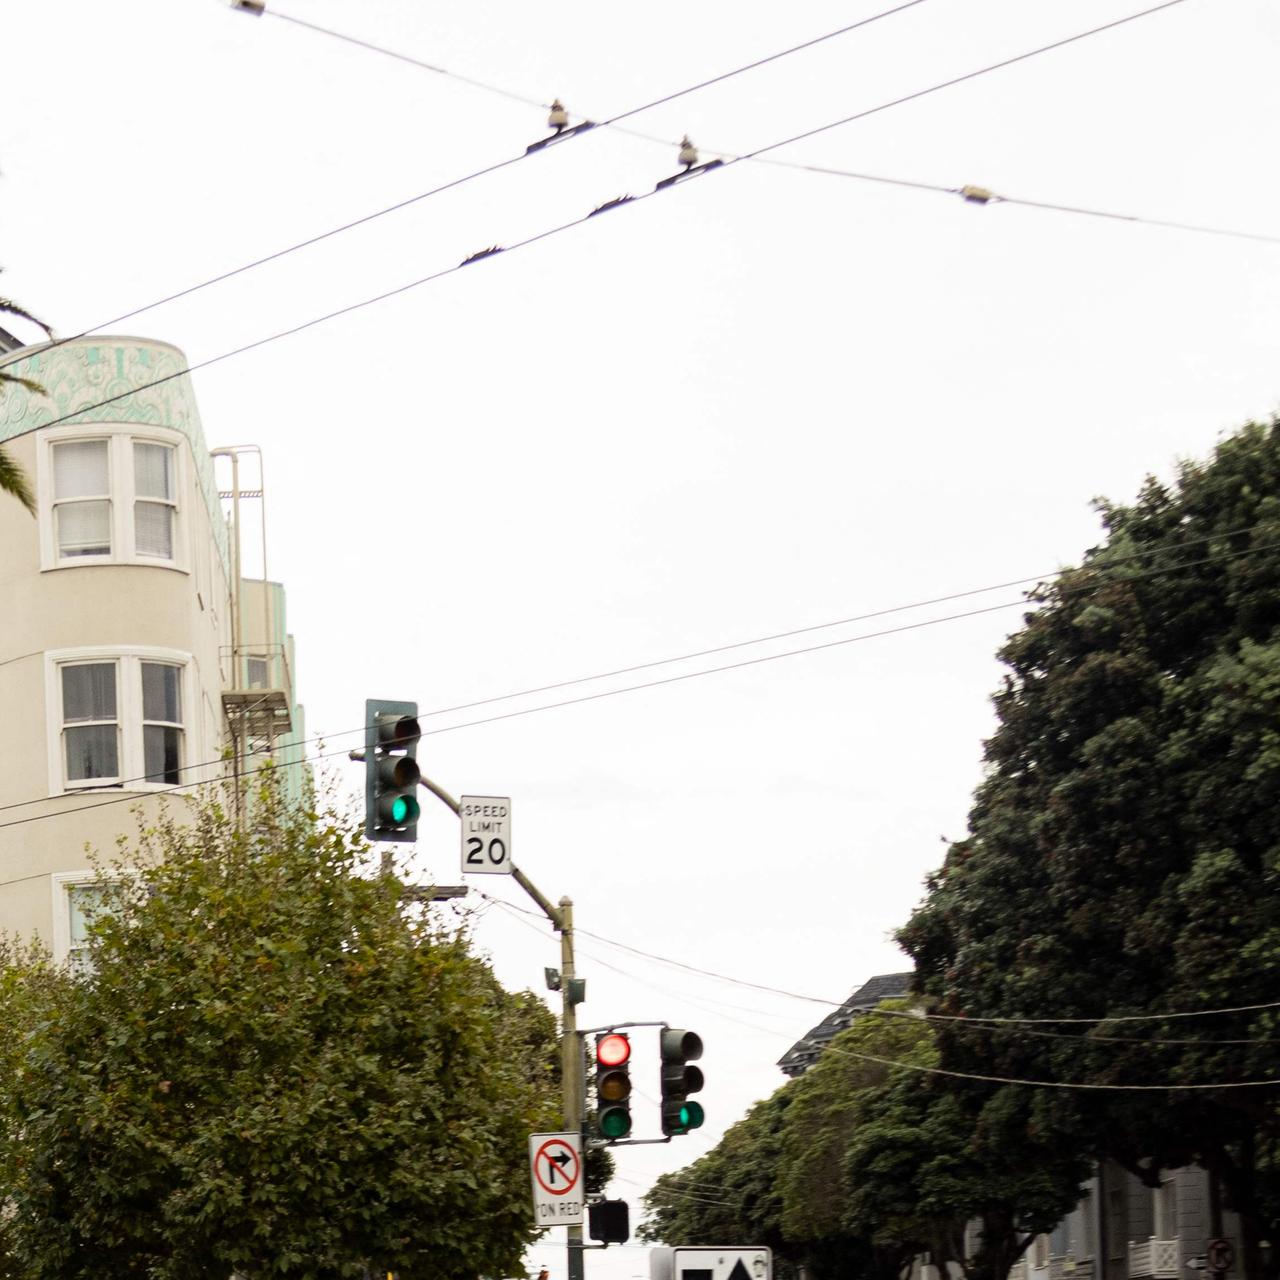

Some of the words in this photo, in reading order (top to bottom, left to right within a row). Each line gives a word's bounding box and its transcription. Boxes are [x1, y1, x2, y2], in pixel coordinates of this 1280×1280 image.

[465, 805, 507, 817] SPEED
[470, 821, 502, 832] LIMIT
[466, 837, 505, 865] 20
[541, 1203, 555, 1217] ON
[559, 1202, 579, 1216] RED
